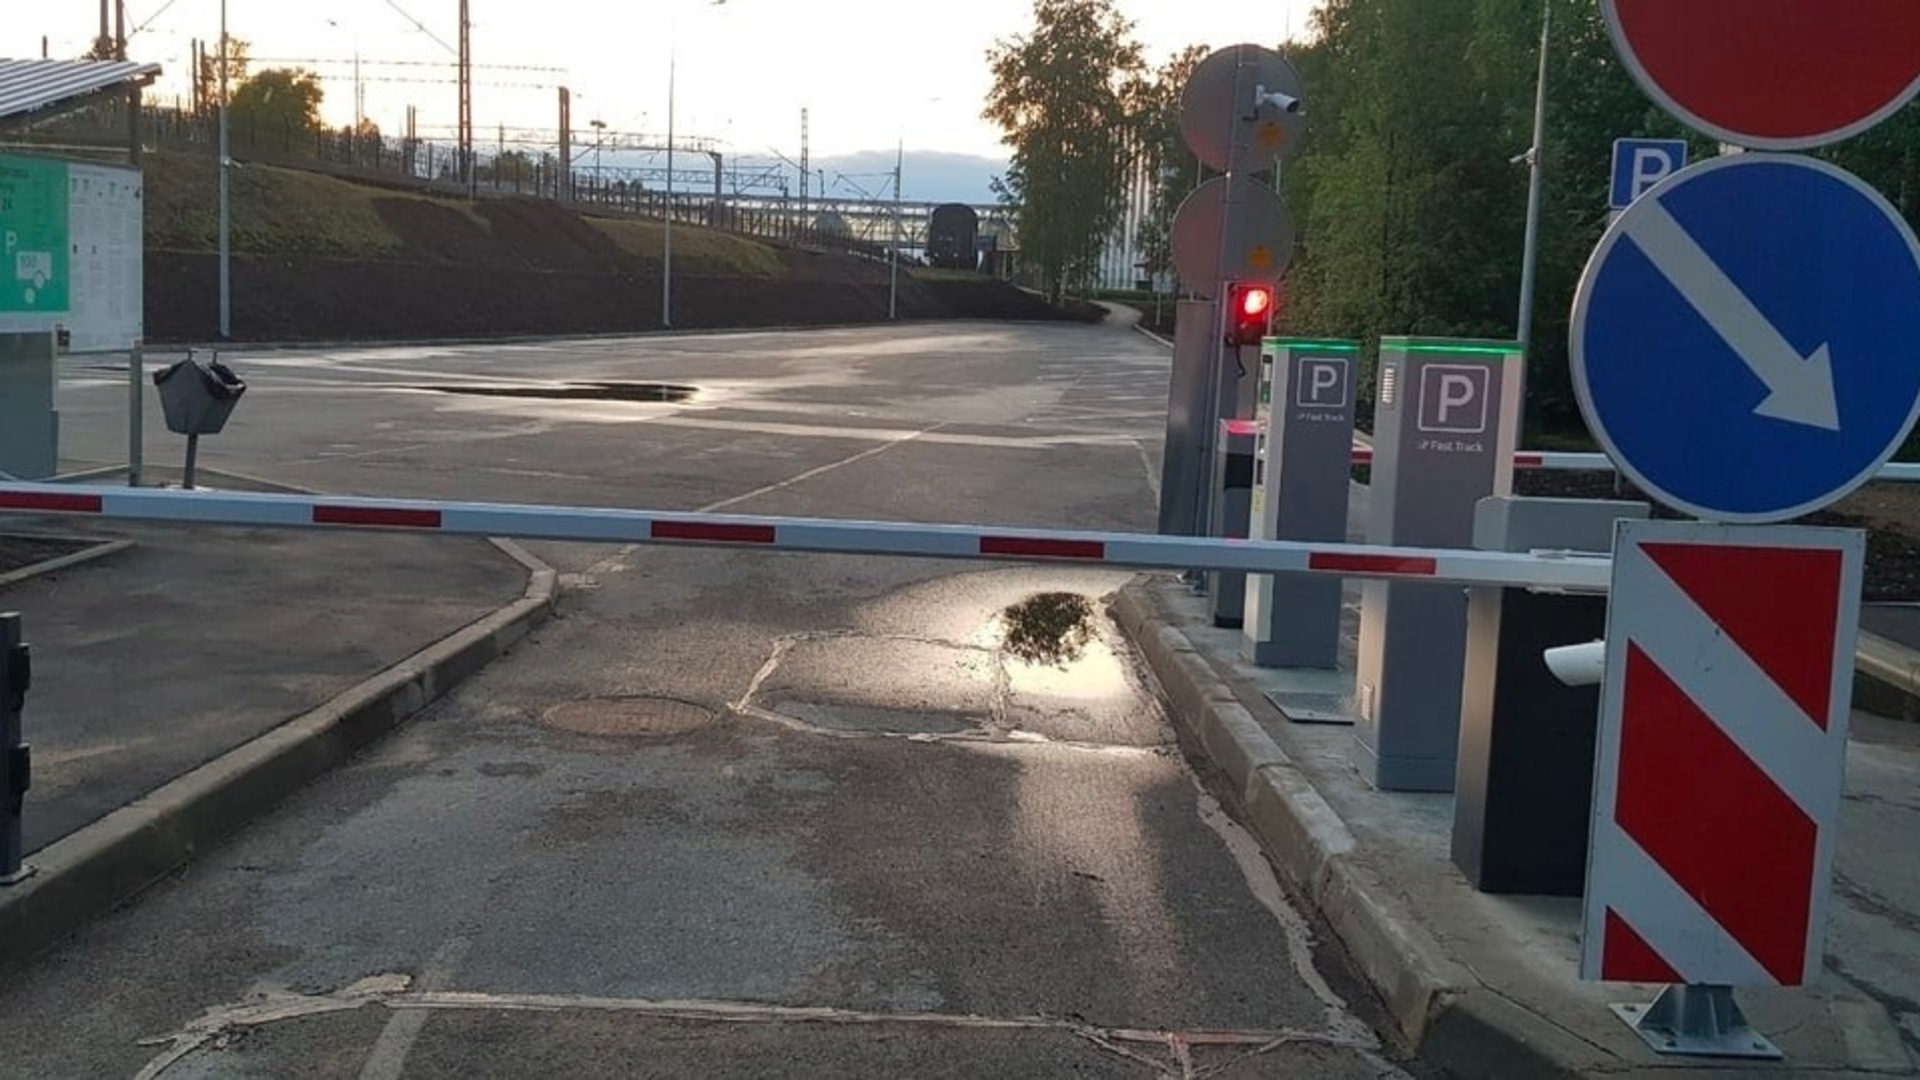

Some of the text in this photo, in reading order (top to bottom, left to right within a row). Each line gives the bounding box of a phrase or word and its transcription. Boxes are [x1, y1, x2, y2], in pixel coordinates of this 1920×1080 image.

[1631, 148, 1671, 200] P
[1311, 365, 1337, 400] P
[1438, 375, 1474, 423] P
[1305, 413, 1345, 422] Fast Track
[1430, 440, 1483, 452] Fast Track
